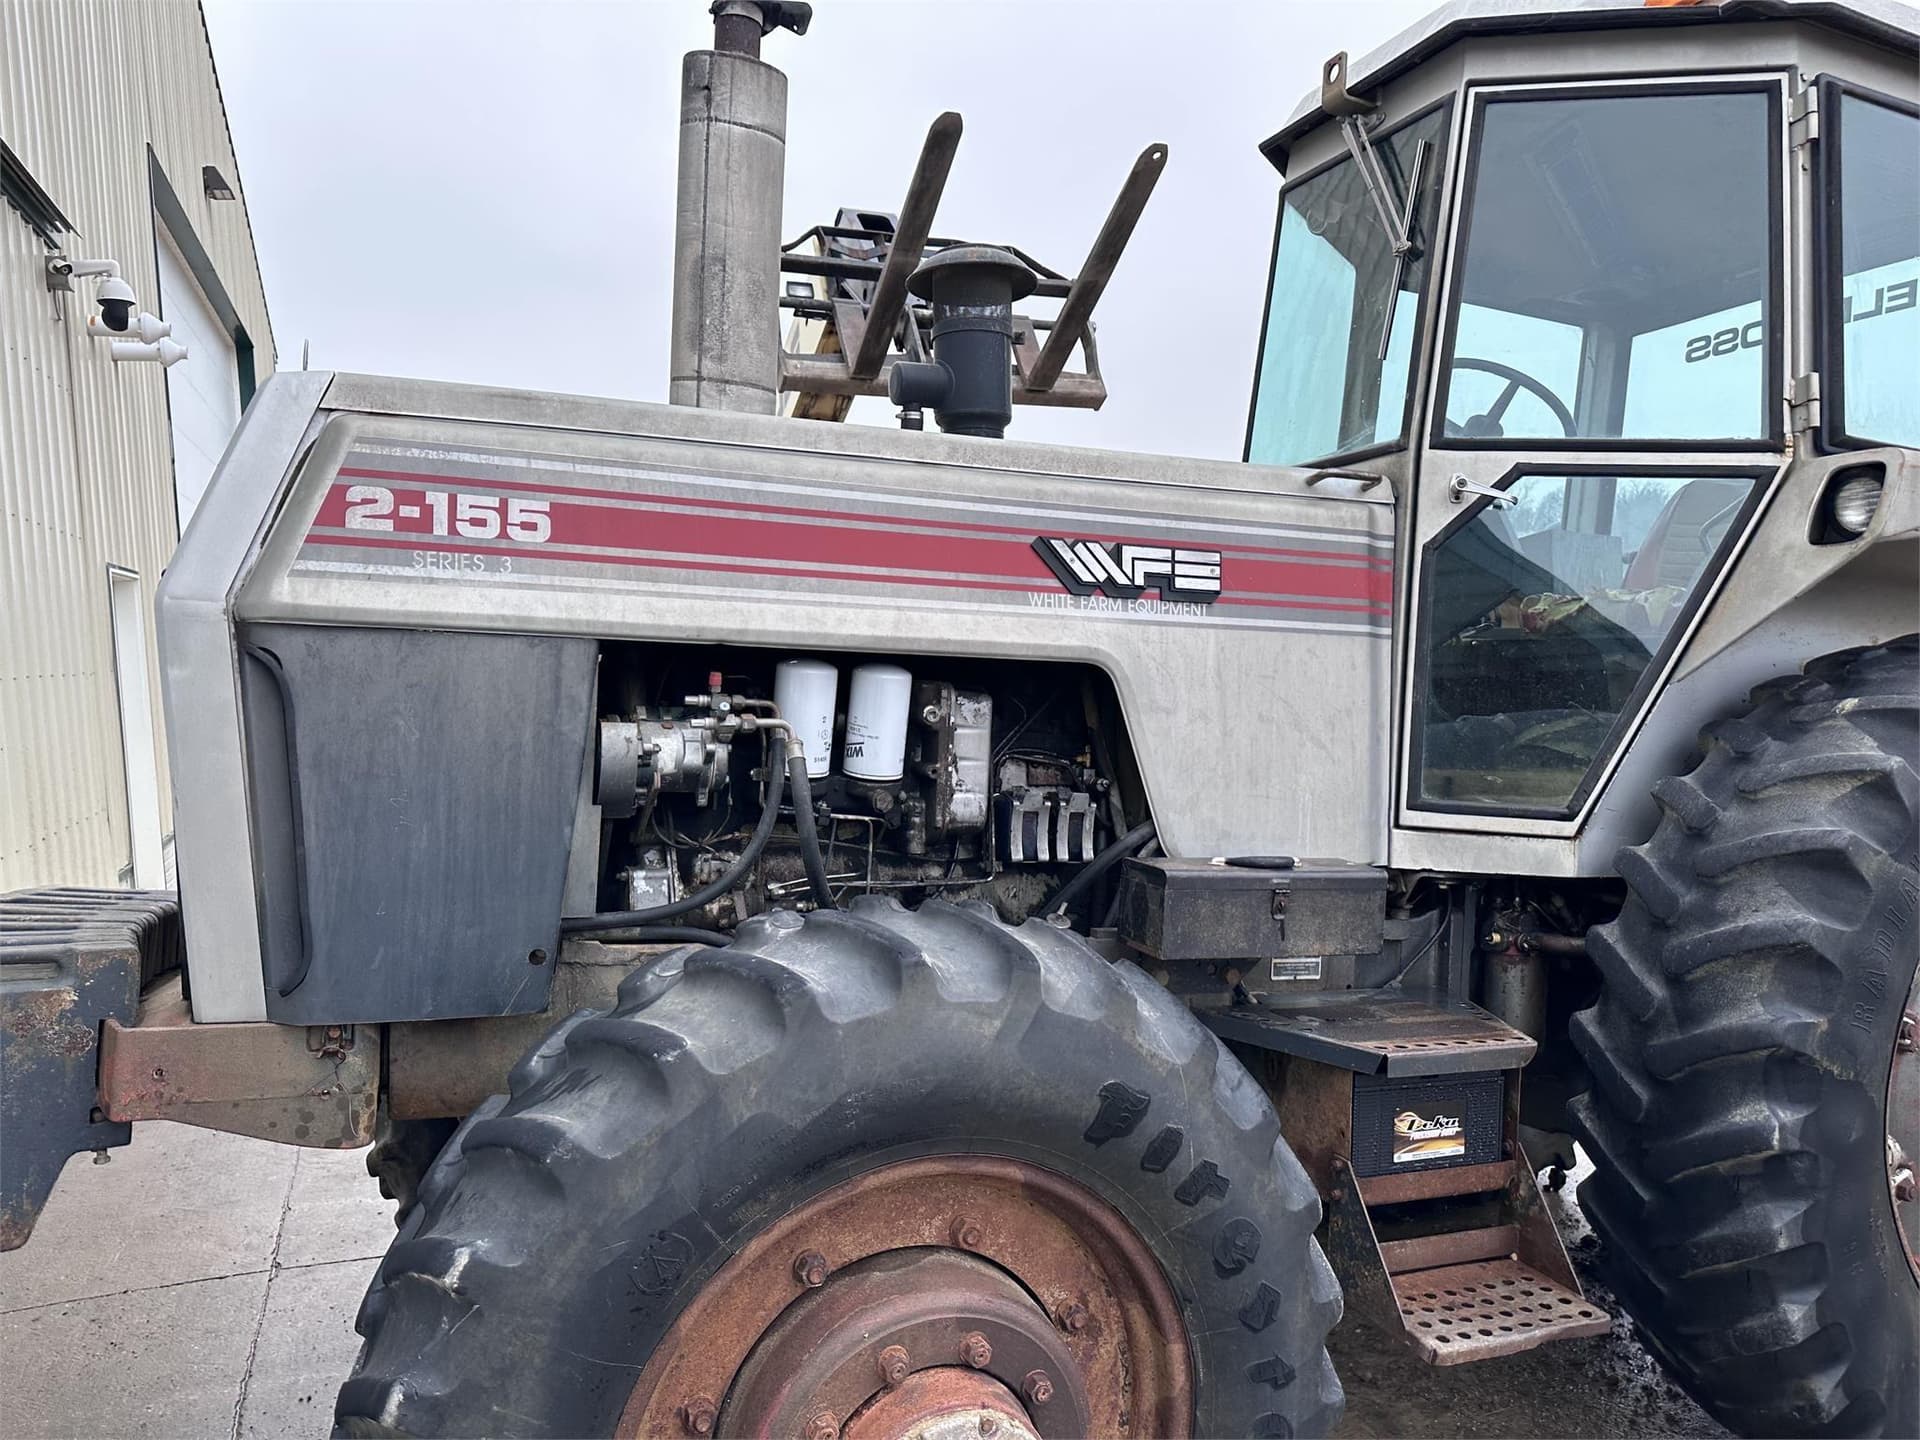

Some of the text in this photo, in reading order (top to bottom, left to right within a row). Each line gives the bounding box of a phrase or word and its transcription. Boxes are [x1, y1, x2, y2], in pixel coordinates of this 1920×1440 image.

[345, 485, 551, 543] 2-155
[412, 550, 513, 574] SERIES 3
[1036, 537, 1222, 598] WFE
[1028, 591, 1208, 617] WHITE FARM EQUIPMENT
[1406, 1115, 1459, 1132] Deka
